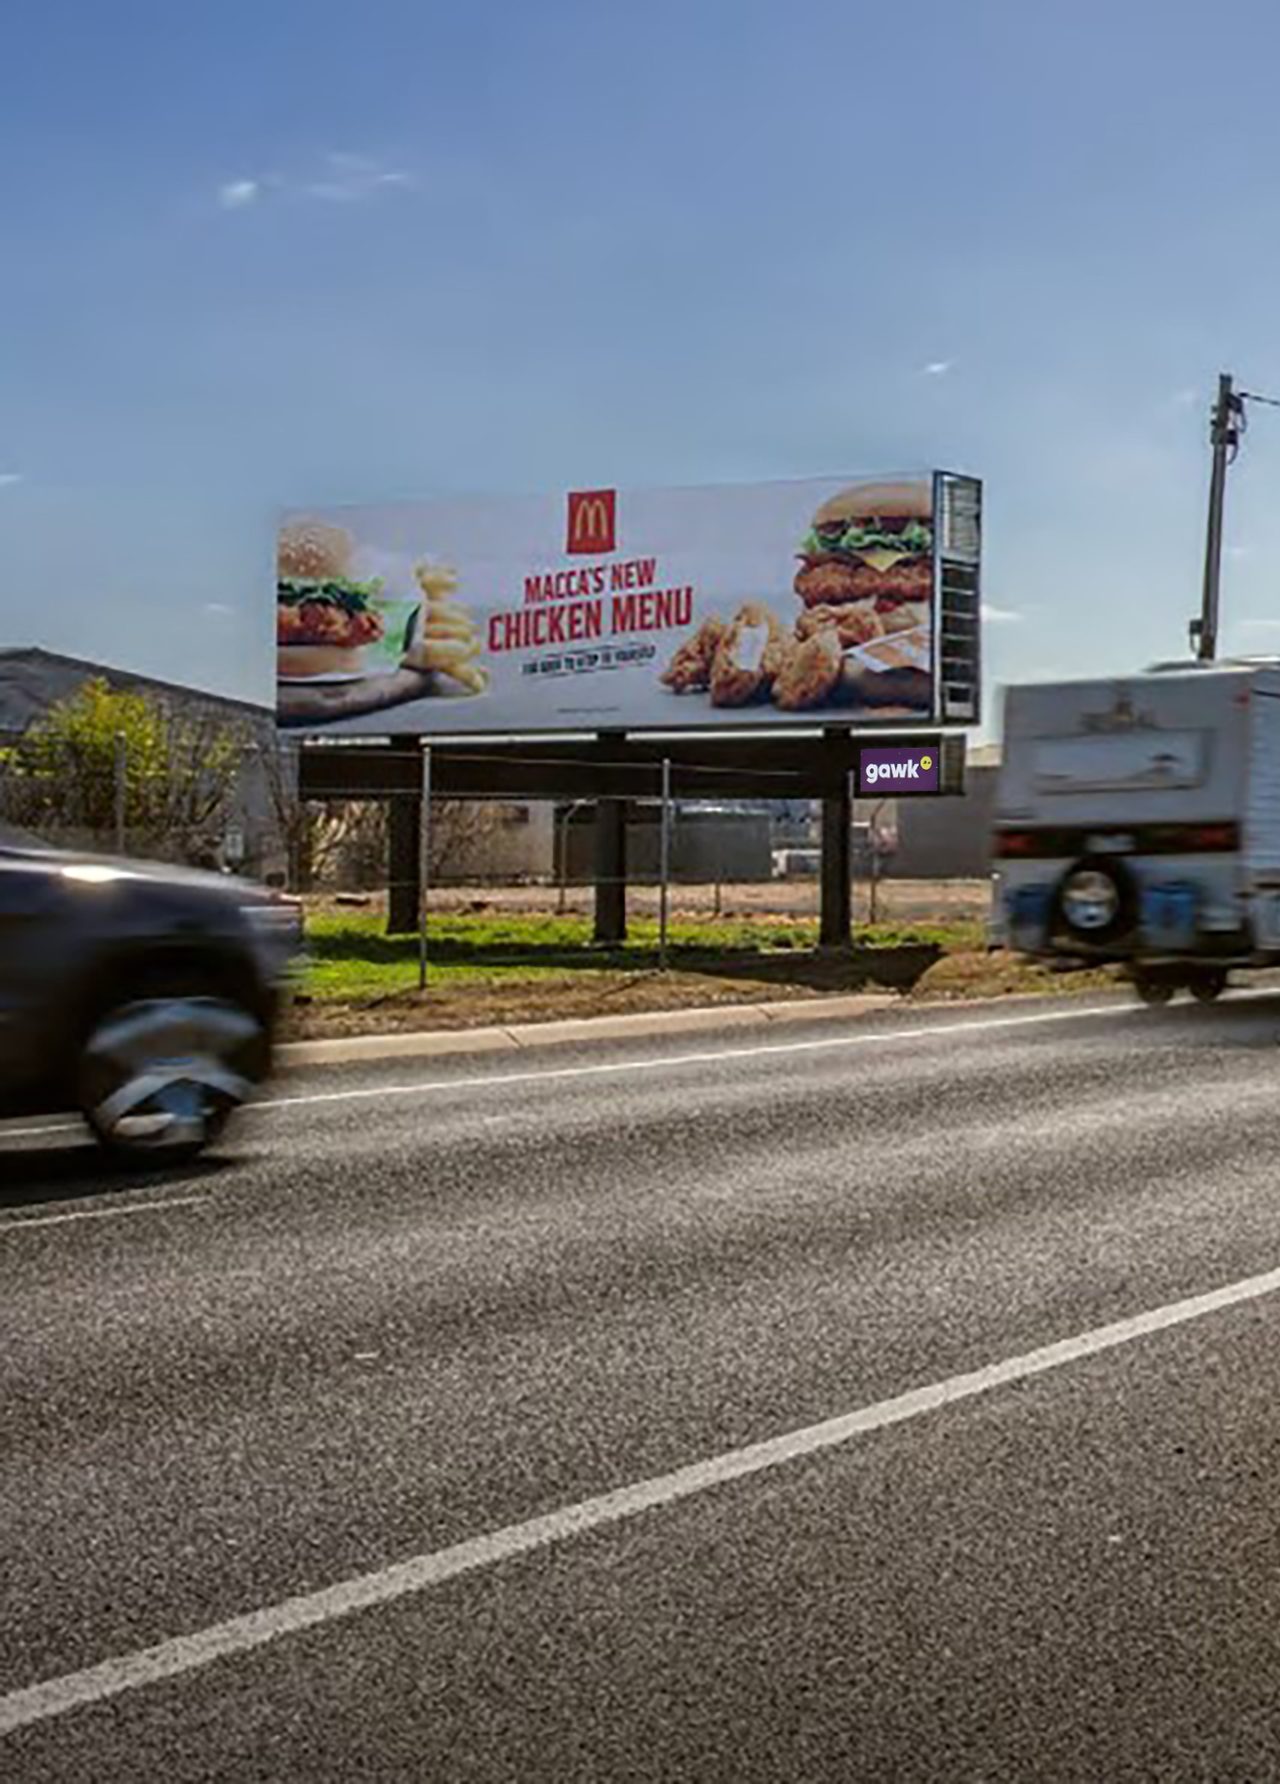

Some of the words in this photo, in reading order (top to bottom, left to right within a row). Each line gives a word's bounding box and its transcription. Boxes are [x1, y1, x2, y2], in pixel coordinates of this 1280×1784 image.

[524, 566, 604, 604] MACCA'S
[611, 558, 656, 592] NEW
[488, 599, 602, 652] CHICKEN
[611, 586, 693, 635] MENU
[865, 759, 920, 784] gawk
